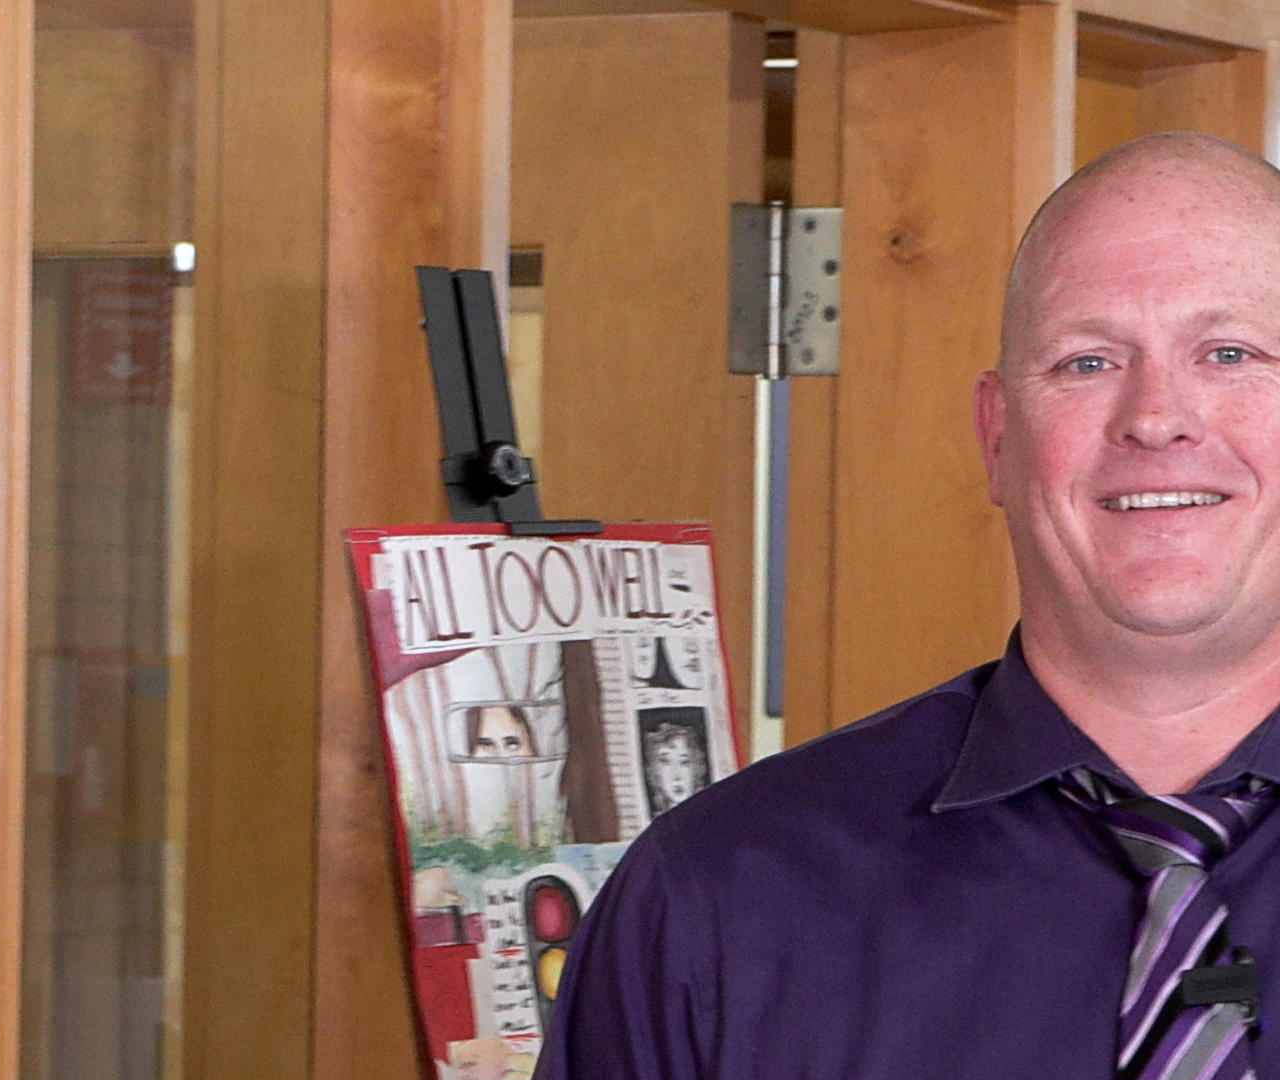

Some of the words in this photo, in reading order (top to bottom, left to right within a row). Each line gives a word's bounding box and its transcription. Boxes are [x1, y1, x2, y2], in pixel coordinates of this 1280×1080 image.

[402, 546, 474, 646] ALL
[468, 541, 582, 635] TOO
[584, 543, 673, 618] WELL
